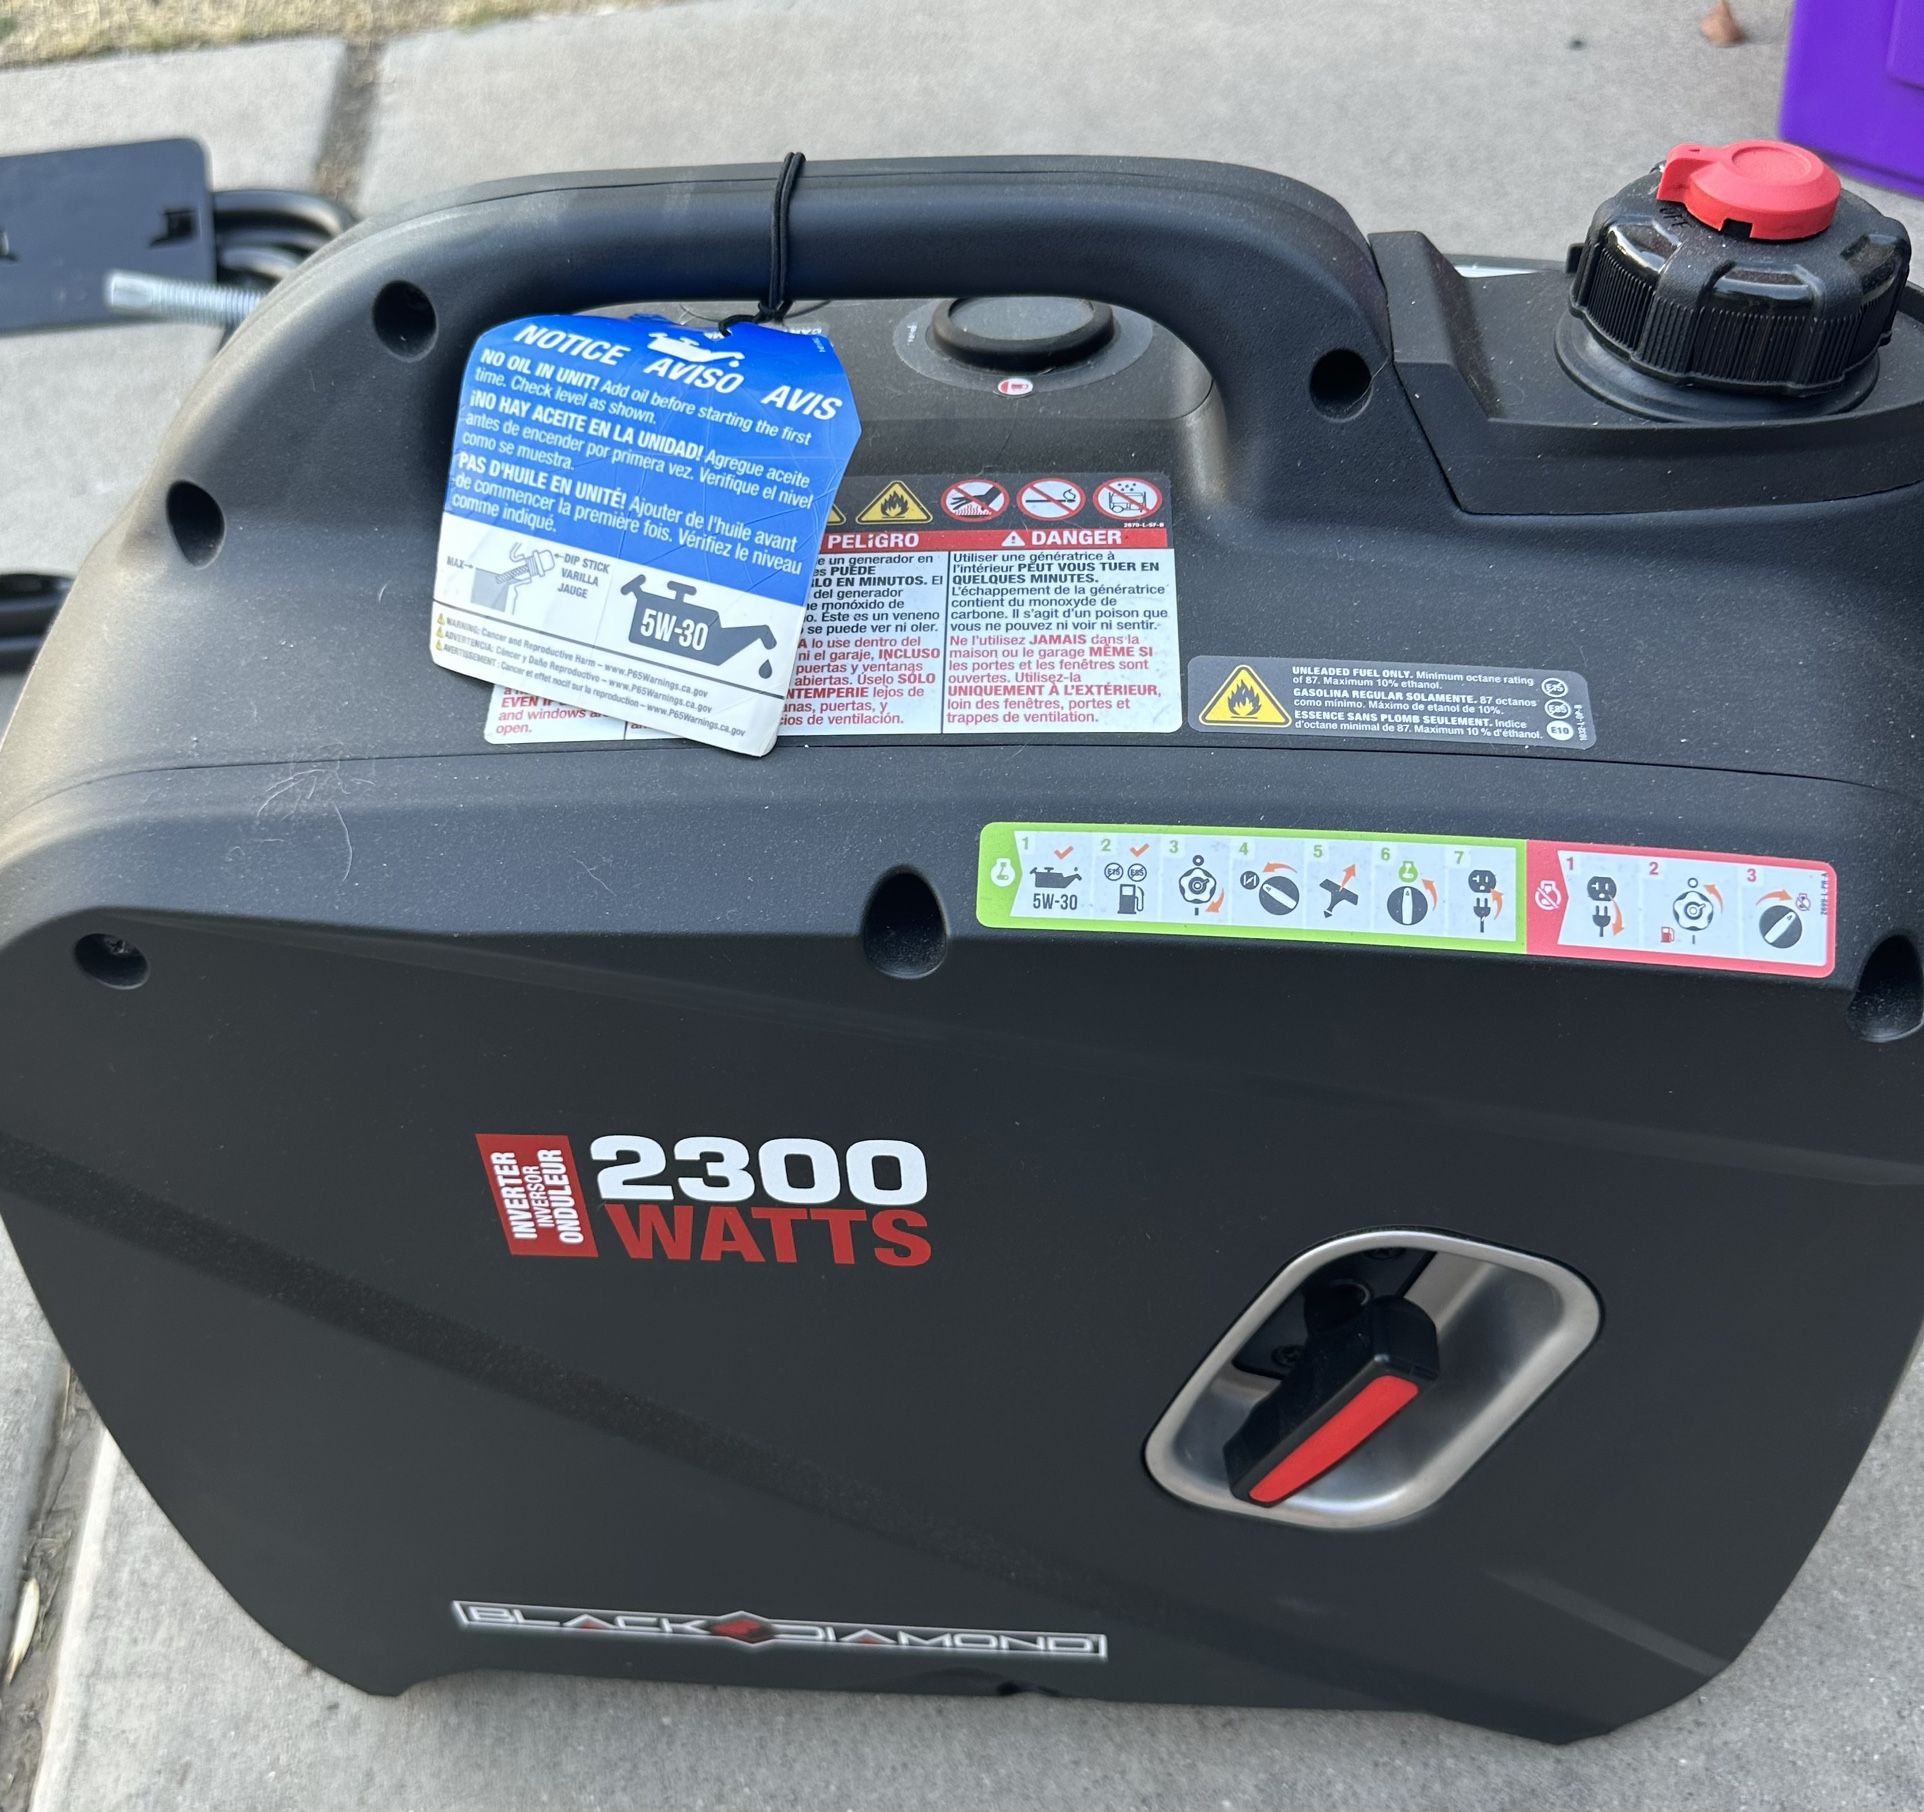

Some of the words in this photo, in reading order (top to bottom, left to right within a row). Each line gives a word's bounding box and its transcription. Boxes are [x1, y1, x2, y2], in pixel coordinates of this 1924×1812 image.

[514, 324, 632, 366] NOTICE
[643, 357, 745, 394] AVISO
[761, 384, 843, 422] AVIS
[474, 366, 506, 387] time.
[510, 375, 553, 398] Check
[554, 386, 588, 407] level
[588, 397, 607, 412] as
[608, 401, 656, 425] shown.
[480, 348, 506, 367] NO
[506, 355, 531, 374] OIL
[535, 362, 555, 379] IN
[556, 367, 601, 390] UNIT!
[600, 380, 631, 398] Add
[631, 389, 650, 403] oil
[650, 392, 696, 415] before
[697, 406, 753, 432] starting
[755, 419, 779, 437] the
[781, 426, 812, 445] first
[499, 396, 531, 418] HAY
[531, 405, 587, 432] ACEITE
[588, 418, 612, 438] EN
[612, 424, 634, 444] LA
[637, 430, 704, 461] UNIDAD!
[704, 449, 764, 477] Agregue
[766, 468, 810, 488] aceite
[461, 431, 496, 450] como
[498, 441, 515, 455] se
[516, 445, 574, 470] muestra.
[465, 411, 500, 432] antes
[502, 419, 520, 436] de
[522, 426, 585, 452] encender
[585, 442, 611, 458] por
[611, 448, 665, 473] primera
[669, 462, 694, 480] vez.
[699, 466, 760, 496] Verifique
[762, 485, 777, 500] el
[778, 489, 814, 509] nivel
[457, 451, 486, 474] PAS
[550, 475, 573, 496] EN
[575, 481, 627, 509] UNITÉ!
[628, 496, 683, 523] Ajouter
[685, 511, 704, 529] de
[754, 531, 798, 553] avant
[451, 493, 500, 517] comme
[502, 503, 556, 532] indiqué.
[457, 471, 472, 490] de
[473, 479, 556, 511] commencer
[557, 497, 572, 516] la
[574, 505, 640, 533] première
[643, 519, 672, 542] fois.
[679, 527, 732, 557] Vérifiez
[734, 543, 749, 561] le
[752, 549, 802, 575] niveau
[1032, 530, 1122, 546] DANGER
[447, 556, 465, 570] MAX
[564, 553, 580, 566] DIP
[582, 558, 611, 574] STICK
[829, 557, 845, 565] un
[848, 554, 914, 566] generador
[917, 555, 933, 563] en
[953, 553, 998, 563] Utiliser
[1001, 554, 1026, 562] une
[1029, 551, 1103, 565] génératrice
[1107, 551, 1115, 561] à
[830, 566, 876, 576] PUEDE
[953, 563, 1014, 573] l'intérieur
[1018, 563, 1054, 572] PEUT
[1057, 562, 1095, 572] VOUS
[1099, 562, 1136, 571] TUER
[1141, 562, 1159, 571] EN
[561, 567, 600, 587] VARILLA
[836, 577, 855, 587] EN
[859, 575, 928, 586] MINUTOS.
[952, 574, 1026, 585] QUELQUES
[1030, 573, 1099, 583] MINUTES.
[557, 582, 588, 599] JAUGE
[813, 589, 833, 599] del
[837, 588, 904, 600] generador
[952, 585, 1050, 598] L'échappement
[1054, 585, 1070, 595] de
[1074, 585, 1086, 595] la
[1089, 584, 1165, 597] génératrice
[951, 597, 1005, 608] contient
[1008, 597, 1025, 607] du
[1029, 596, 1097, 609] monoxyde
[1100, 596, 1117, 606] de
[951, 609, 1008, 620] carbone.
[1012, 608, 1019, 619] Il
[1023, 608, 1059, 620] s'agit
[1062, 608, 1091, 618] d'un
[1095, 608, 1139, 620] poison
[1143, 610, 1168, 620] que
[641, 608, 709, 652] 5W-30
[807, 626, 823, 634] se
[826, 623, 867, 636] puede
[870, 624, 892, 633] ver
[895, 622, 907, 632] ni
[910, 622, 938, 632] oler.
[950, 623, 981, 632] vous
[985, 622, 1001, 631] ne
[1005, 622, 1052, 633] pouvez
[1056, 620, 1068, 630] ni
[1072, 620, 1097, 630] voir
[1100, 620, 1112, 630] ni
[1116, 620, 1157, 630] sentir.
[1292, 666, 1350, 676] UNLEADED
[1352, 668, 1380, 677] FUEL
[1382, 669, 1414, 679] ONLY.
[1416, 671, 1464, 681] Minimum
[1466, 674, 1502, 683] octane
[1503, 676, 1534, 686] rating
[501, 697, 539, 708] EVEN
[1293, 688, 1349, 698] GASOLINA
[1352, 690, 1404, 700] REGULAR
[1406, 692, 1478, 704] SOLAMENTE.
[1479, 695, 1493, 704] 87
[1495, 698, 1537, 707] octanos
[498, 709, 525, 721] and
[527, 707, 586, 720] windows
[1294, 710, 1345, 720] ESSENCE
[1347, 712, 1378, 722] SANS
[1380, 713, 1420, 723] PLOMB
[1422, 715, 1493, 727] SEULEMENT.
[496, 724, 533, 736] open.
[1022, 837, 1029, 850] 1
[1100, 838, 1111, 852] 2
[1169, 840, 1179, 853] 3
[1238, 842, 1249, 855] 4
[1313, 844, 1323, 858] 5
[1380, 847, 1391, 861] 6
[1454, 850, 1465, 864] 7
[1566, 856, 1575, 870] 1
[1649, 861, 1660, 875] 2
[1746, 868, 1757, 882] 3
[1033, 892, 1078, 911] 5W-30
[591, 1135, 928, 1206] 2300
[491, 1152, 538, 1240] INVERTER
[524, 1165, 555, 1228] INVERSOR
[539, 1149, 584, 1244] ONDULEUR
[606, 1204, 933, 1267] WATTS
[468, 1605, 710, 1634] BLACK
[777, 1625, 1094, 1654] DIAMOND
